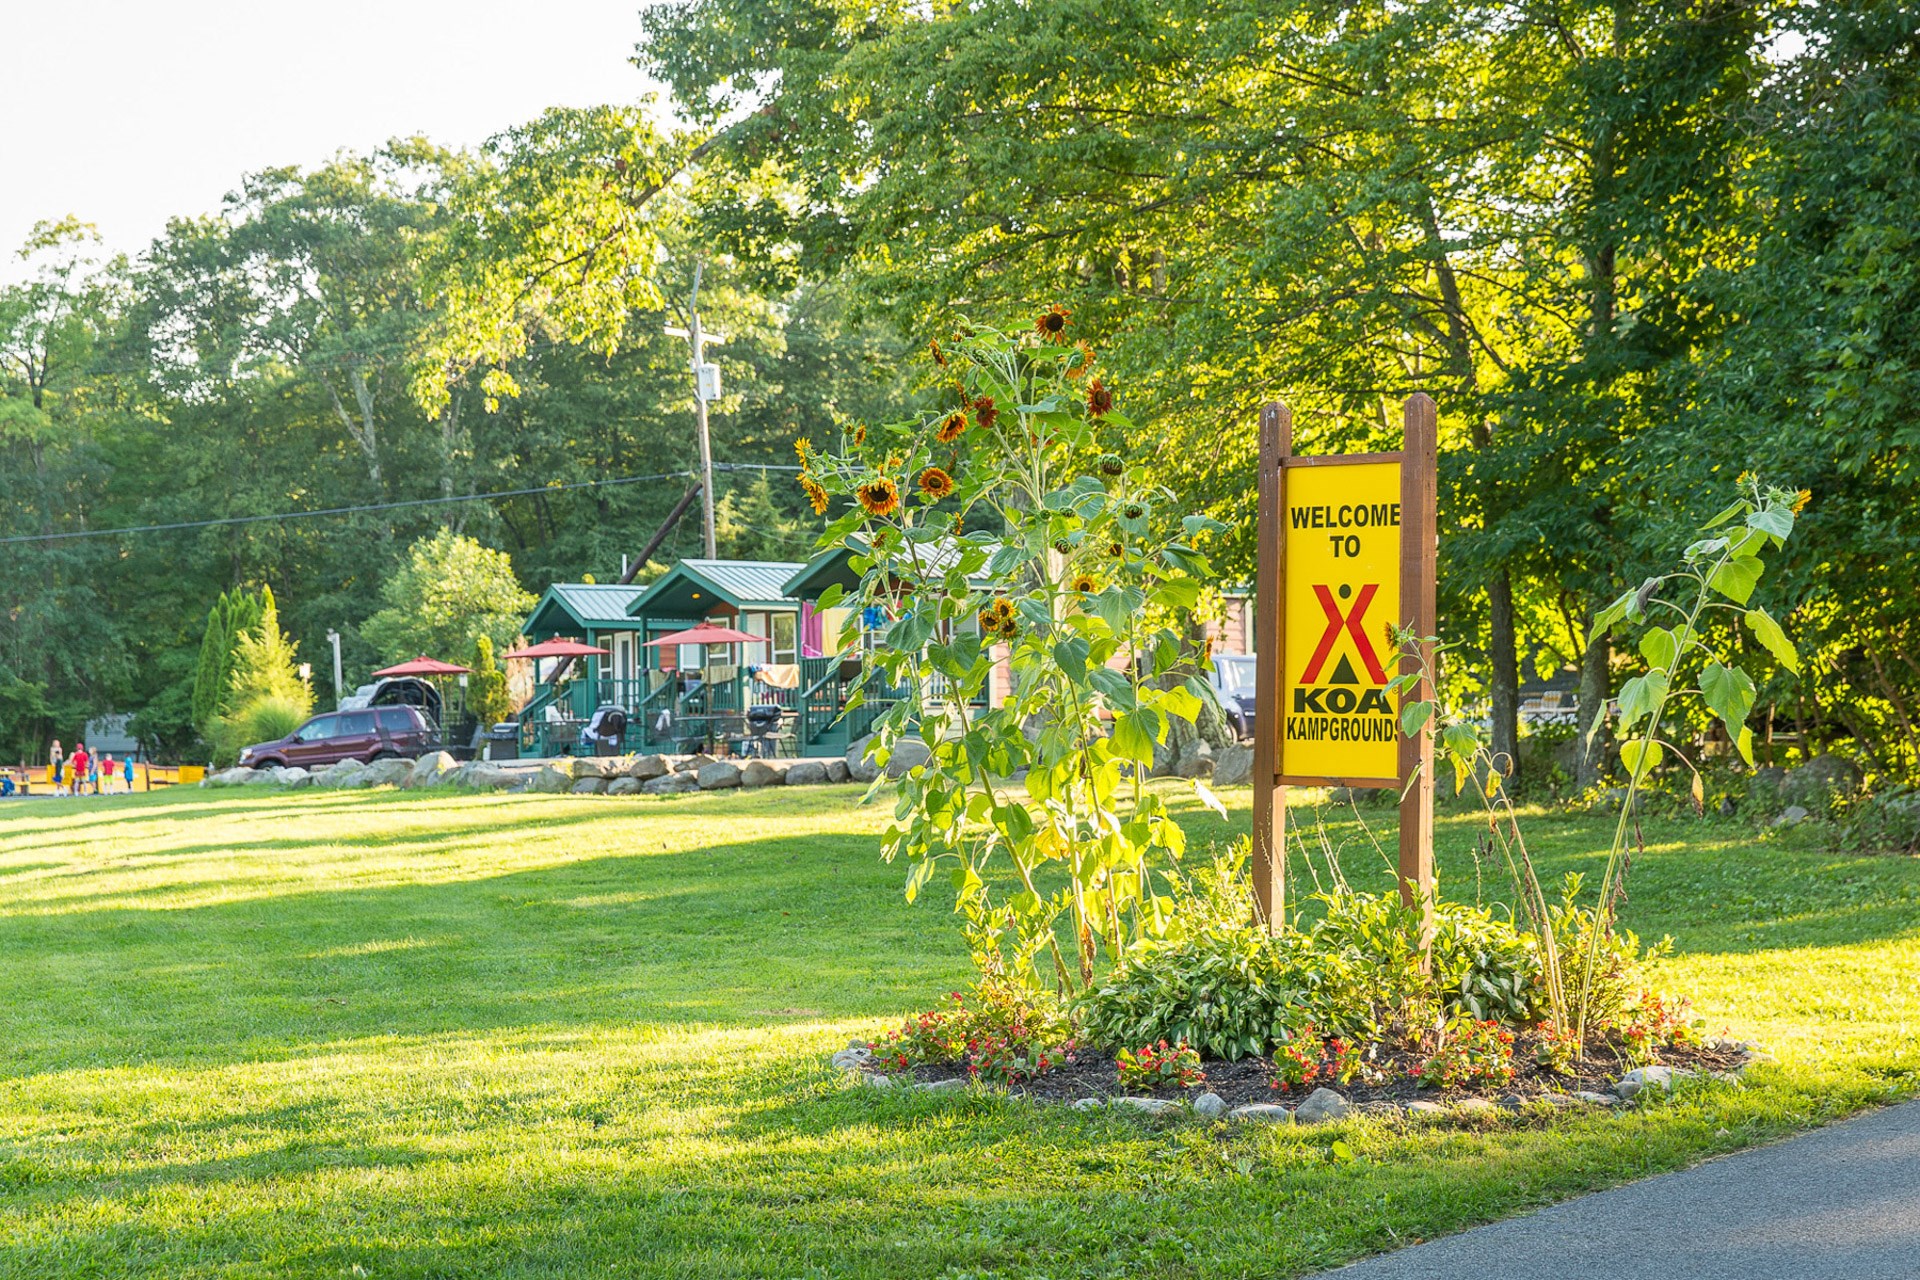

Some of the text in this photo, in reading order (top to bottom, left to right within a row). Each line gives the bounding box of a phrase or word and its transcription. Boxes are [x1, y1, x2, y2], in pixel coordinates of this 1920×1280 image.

[1291, 504, 1400, 529] WELCOME
[1330, 535, 1360, 558] TO
[1294, 688, 1394, 714] KOA
